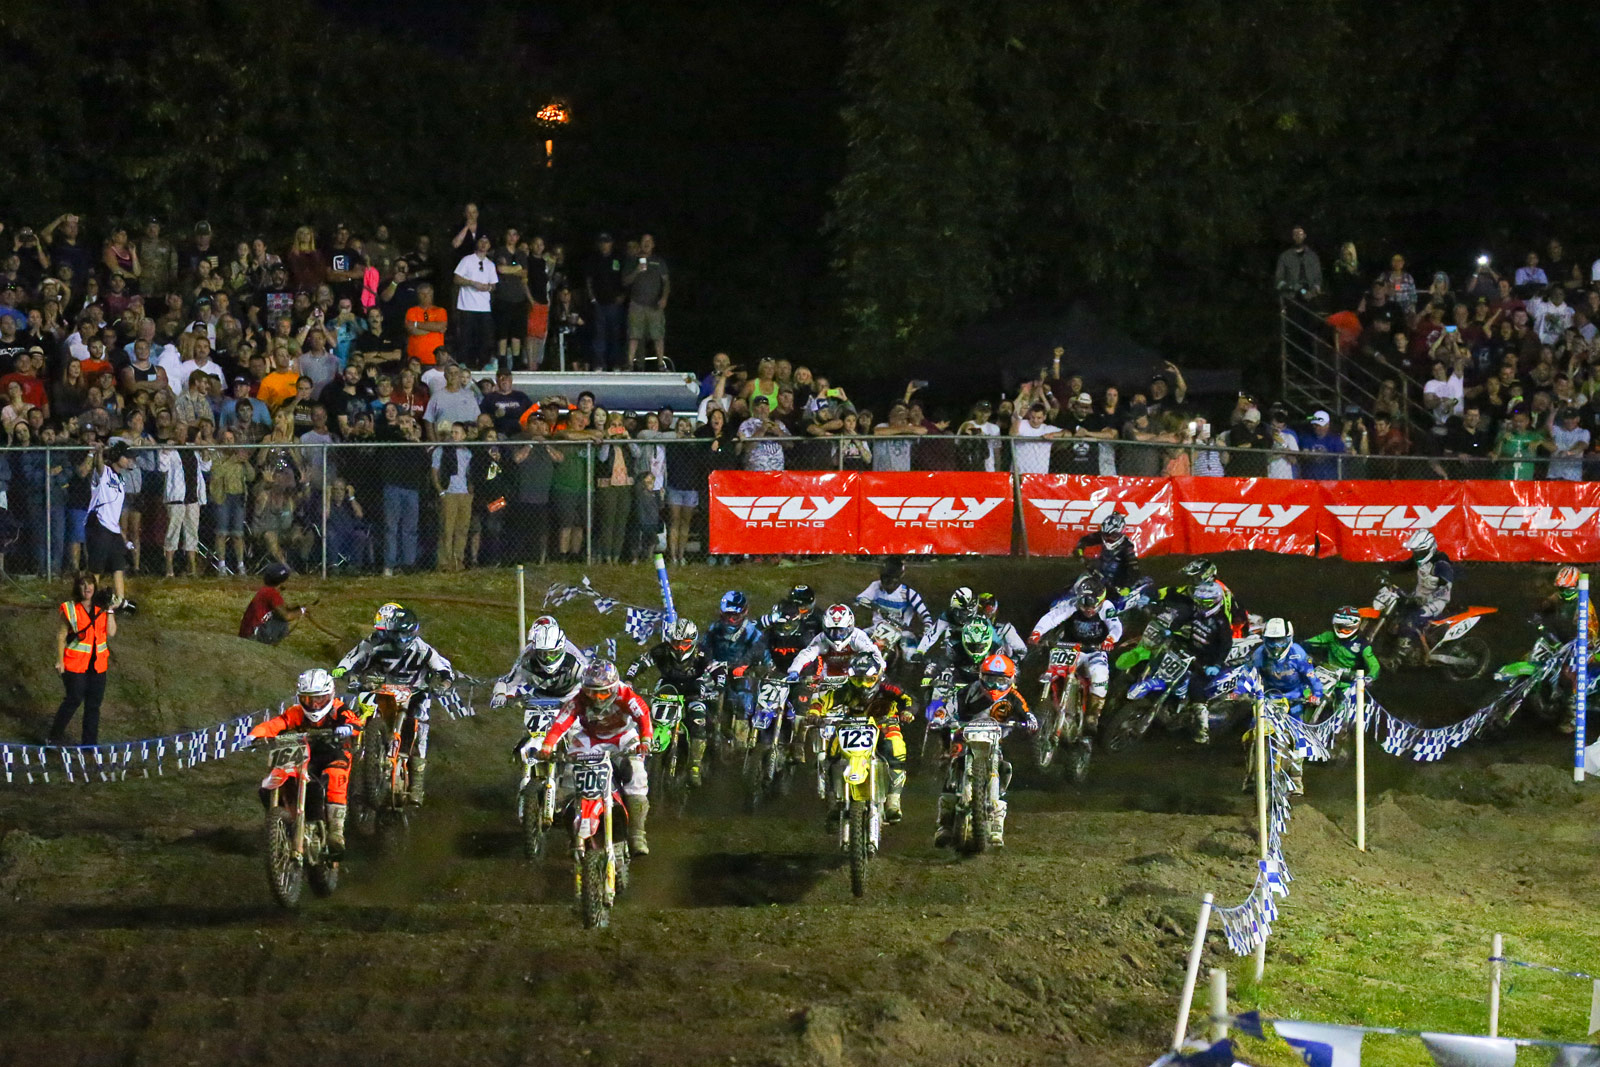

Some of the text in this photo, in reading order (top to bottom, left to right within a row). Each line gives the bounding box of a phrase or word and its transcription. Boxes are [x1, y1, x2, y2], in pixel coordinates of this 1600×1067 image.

[716, 496, 852, 520] FLY
[866, 496, 1006, 520] FLY
[1028, 498, 1165, 525] FLY
[1178, 502, 1310, 527] FLY
[1324, 505, 1456, 529] FLY
[1470, 506, 1599, 530] FLY
[1056, 524, 1135, 532] RACG
[1204, 527, 1280, 535] RACING
[1353, 529, 1413, 537] RACIN
[1049, 652, 1075, 665] 609
[1577, 645, 1586, 720] HOLESHOT
[841, 730, 873, 749] 123
[1576, 725, 1585, 757] LINE
[574, 770, 607, 791] 506
